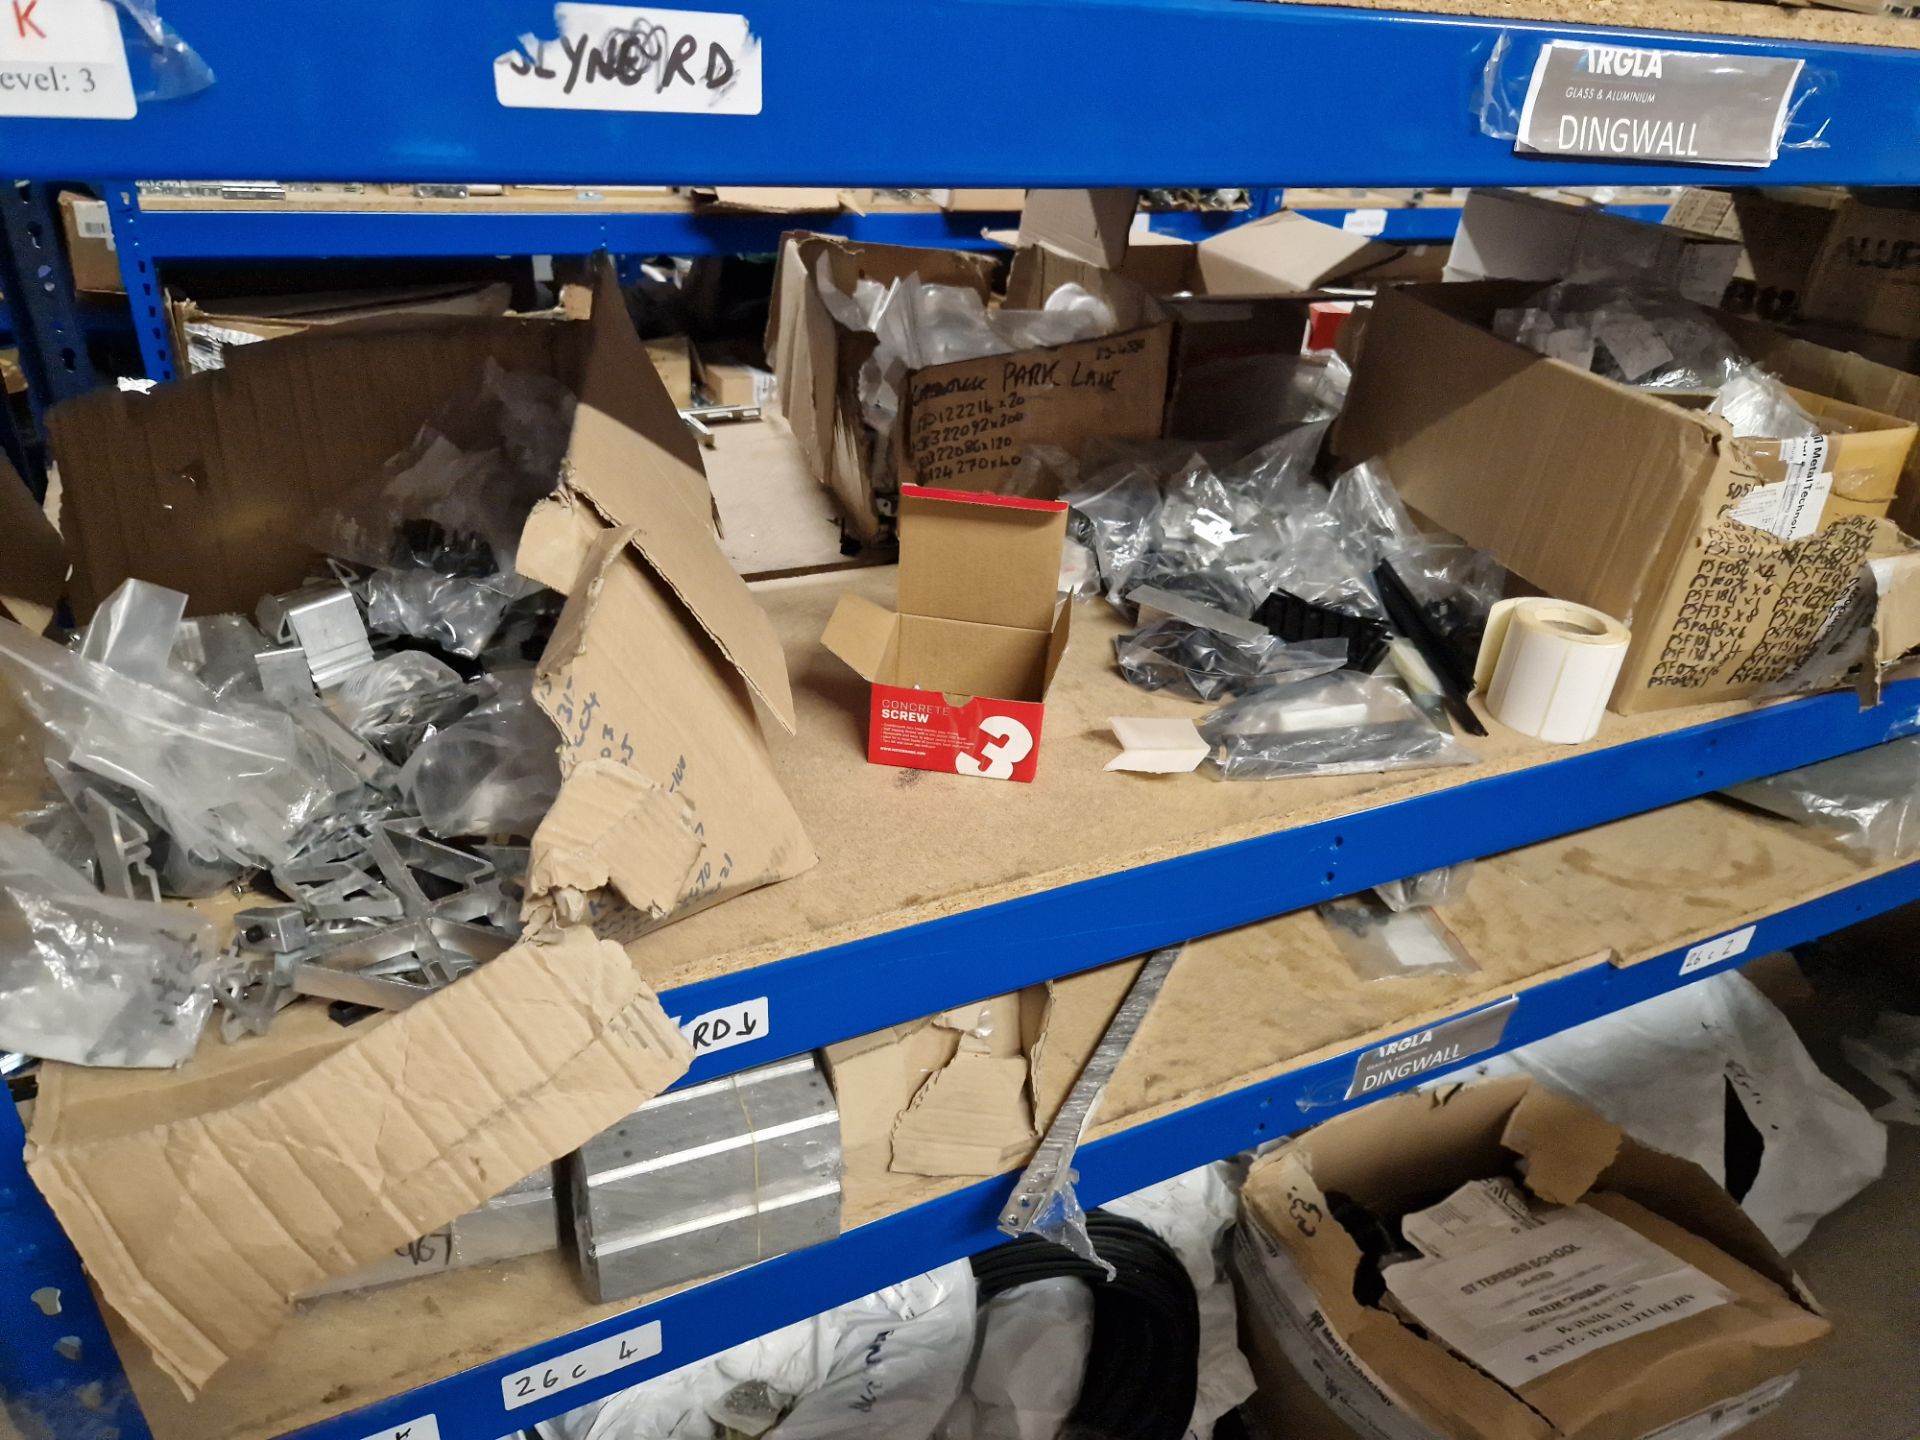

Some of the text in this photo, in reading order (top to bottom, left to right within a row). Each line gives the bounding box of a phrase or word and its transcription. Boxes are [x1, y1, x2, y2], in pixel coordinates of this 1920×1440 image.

[79, 68, 95, 93] 3
[1565, 86, 1656, 104] GLASS & ALUMINIUM
[1558, 114, 1699, 156] DINGWALL
[1003, 361, 1060, 392] PARK
[1803, 445, 1823, 490] Metal
[881, 709, 929, 724] SCREW
[882, 699, 950, 716] CONCRETE
[692, 1018, 732, 1050] RD
[1362, 1044, 1460, 1092] DINGWALL
[1527, 1242, 1583, 1270] SCHOOL
